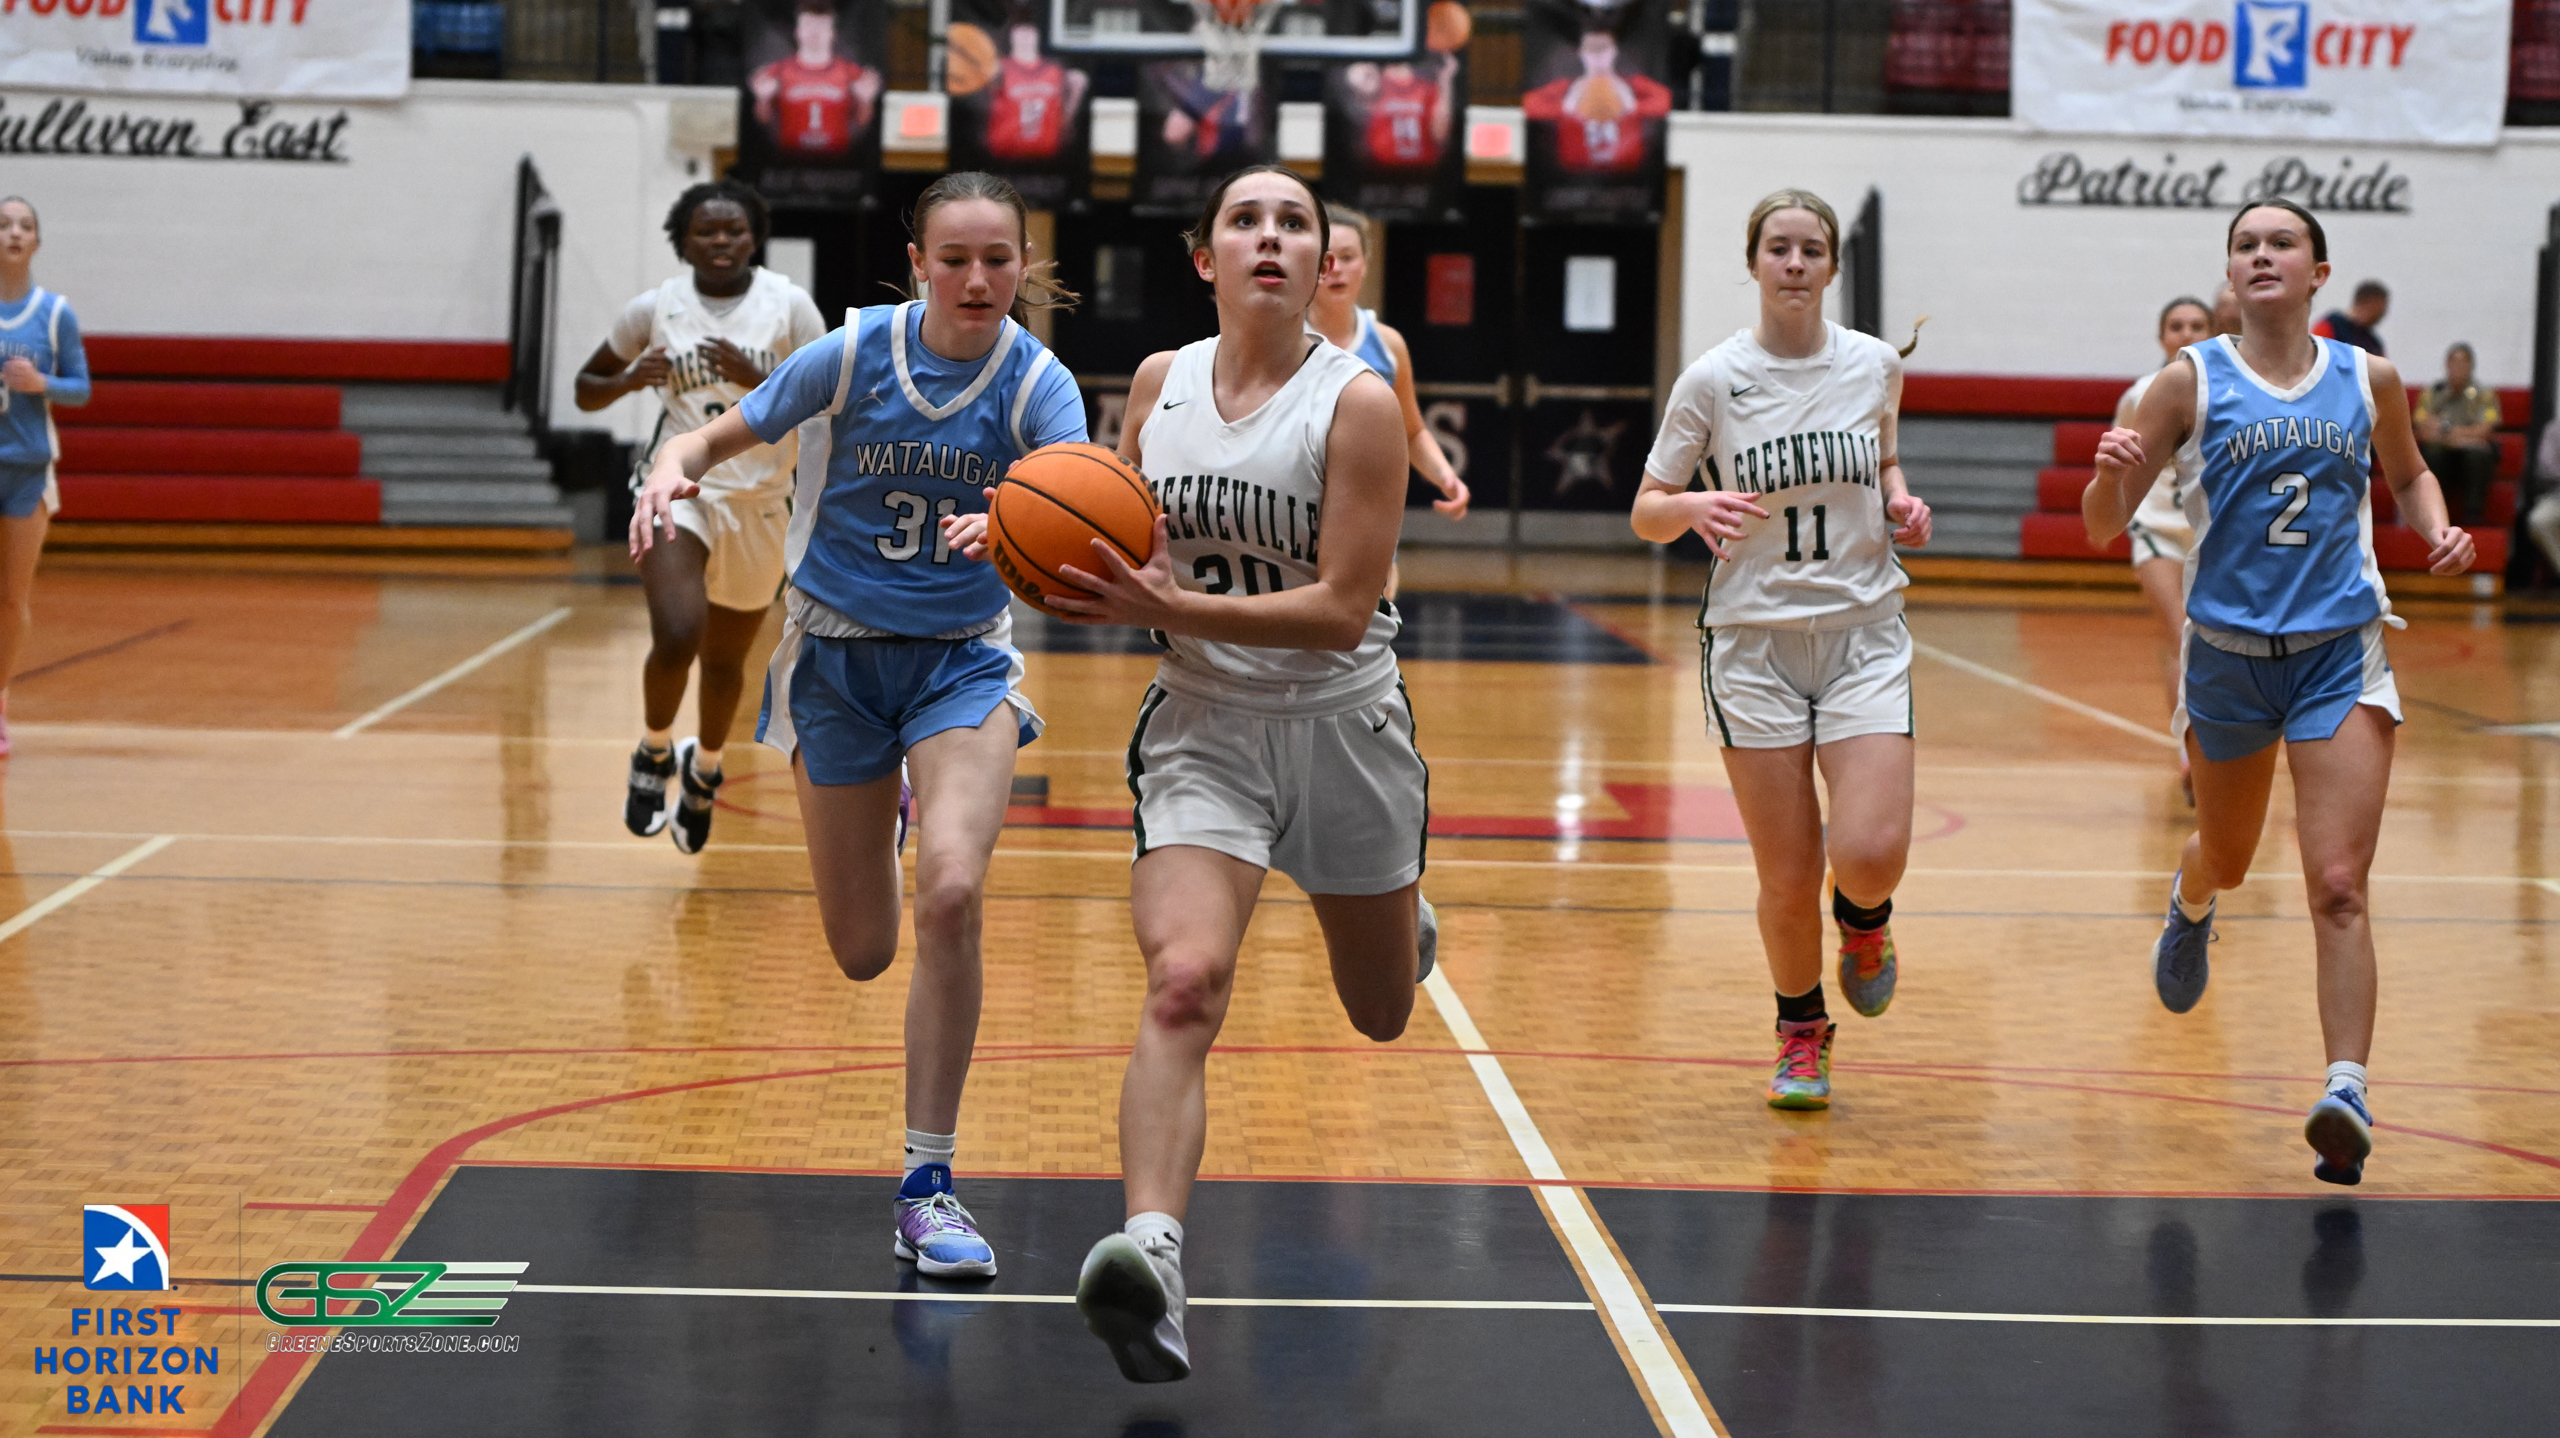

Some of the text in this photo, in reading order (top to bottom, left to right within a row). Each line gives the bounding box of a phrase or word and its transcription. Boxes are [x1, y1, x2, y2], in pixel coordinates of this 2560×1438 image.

[2107, 19, 2415, 67] FOOD CITY
[0, 98, 348, 160] ullivan East
[2017, 150, 2413, 213] Patriot Pride
[856, 439, 998, 487] WATAUGA
[2226, 416, 2357, 466] WATAUGA
[874, 489, 959, 566] 31
[1152, 474, 1319, 564] EENEVILLE
[1784, 504, 1830, 562] 11
[2266, 471, 2311, 547] 2
